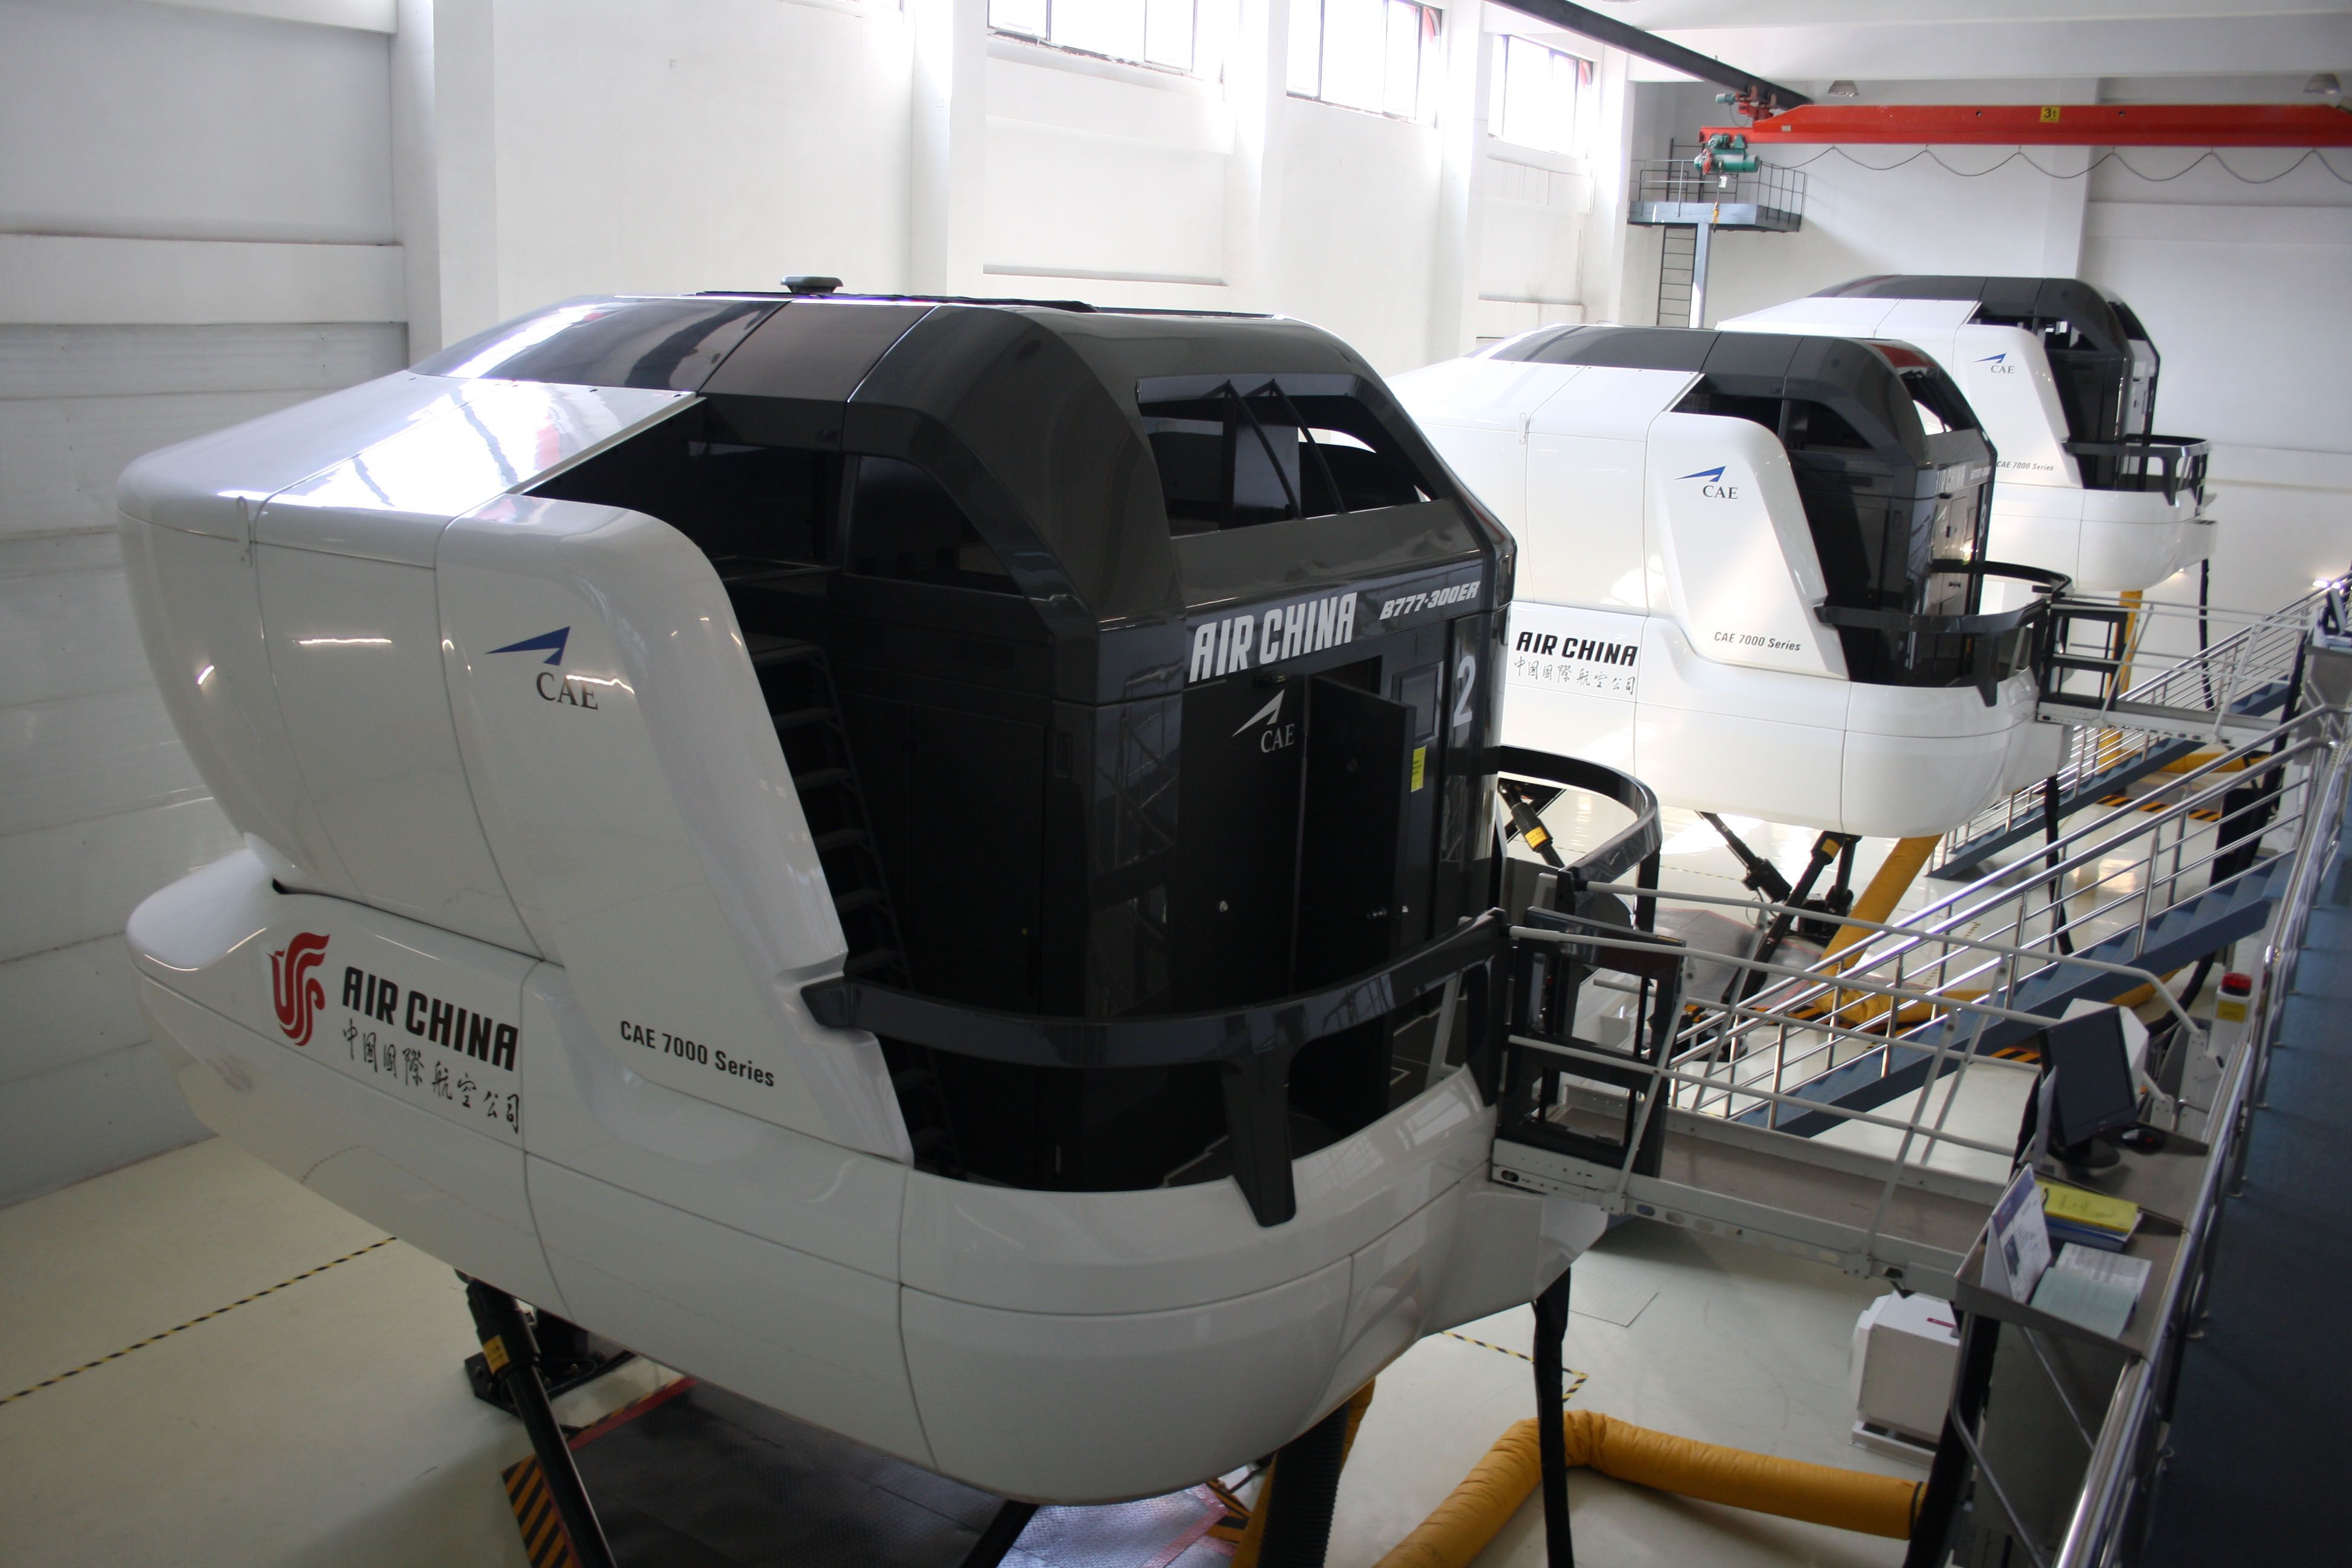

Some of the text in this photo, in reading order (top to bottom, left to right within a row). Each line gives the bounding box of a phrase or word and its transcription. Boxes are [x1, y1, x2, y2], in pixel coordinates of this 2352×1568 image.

[2044, 108, 2056, 119] 3t
[1990, 365, 2014, 374] CAE
[1703, 485, 1738, 500] CAE
[1379, 581, 1481, 620] B777-300ER
[1189, 592, 1357, 683] AIR CHINA
[1516, 631, 1638, 667] AIR CHINA
[1714, 632, 1801, 651] CAE 7000 Series
[536, 671, 598, 710] CAE
[1452, 655, 1476, 727] 2
[1261, 724, 1295, 753] CAE
[342, 966, 518, 1072] AIR CHINA
[621, 1021, 774, 1086] CAE 7000 Series
